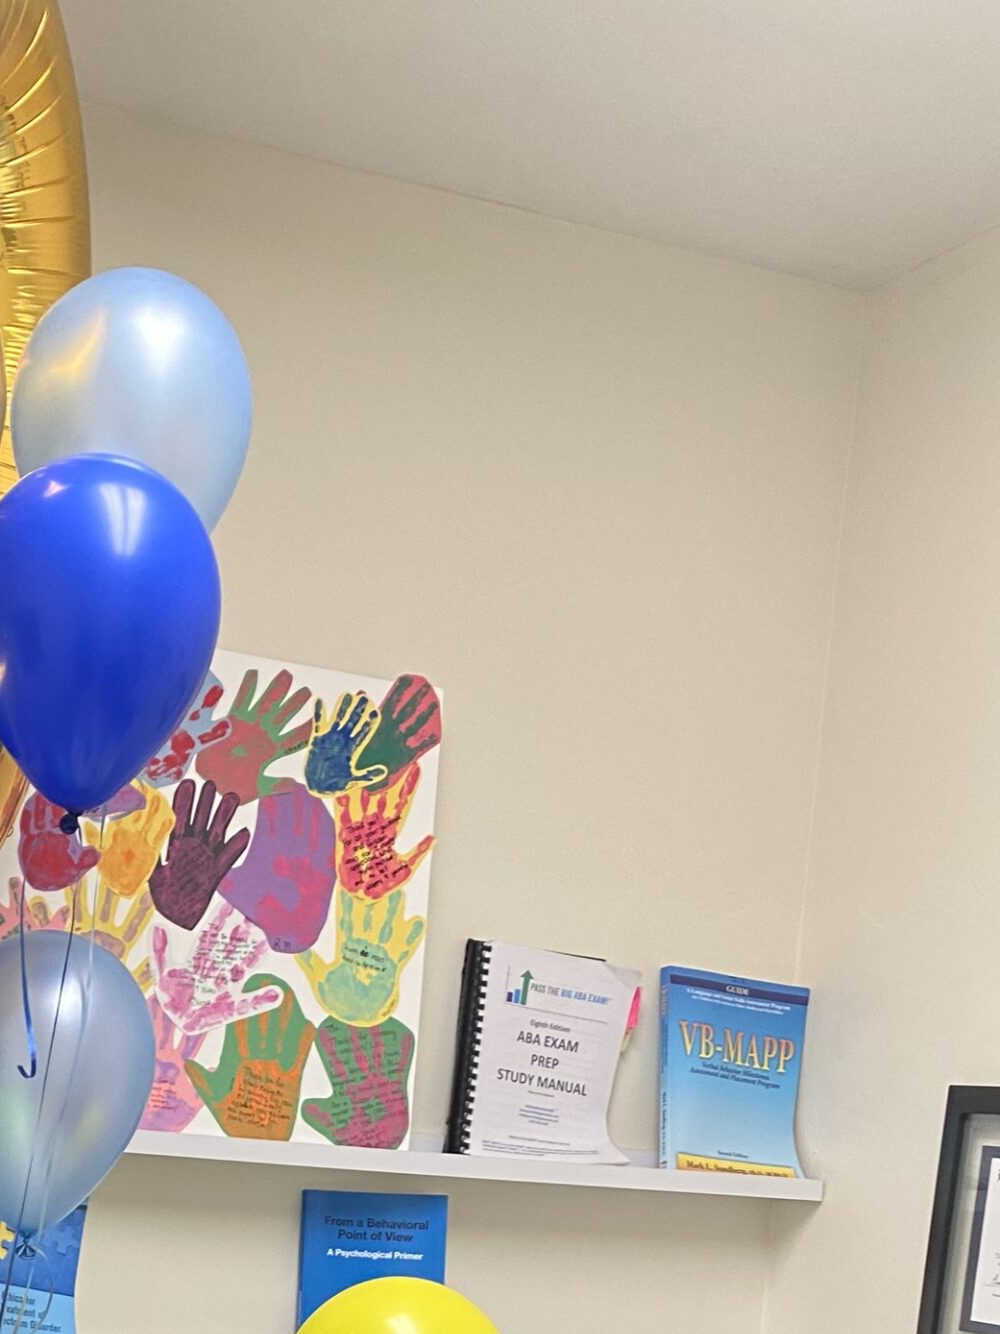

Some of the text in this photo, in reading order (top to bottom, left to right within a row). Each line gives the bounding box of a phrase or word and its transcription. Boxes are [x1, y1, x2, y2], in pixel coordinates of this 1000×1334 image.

[530, 982, 547, 994] PASS
[547, 986, 561, 997] THE
[561, 988, 573, 999] BIG
[573, 991, 587, 1001] ABA
[725, 985, 750, 996] GUIDE
[529, 1019, 571, 1033] Eighth Edition
[516, 1030, 580, 1053] ABA EXAM
[679, 1020, 796, 1074] VB-MAPP
[530, 1053, 560, 1069] PREP
[496, 1067, 587, 1096] STUDY MANUAL
[324, 1215, 430, 1231] From a Behavioral
[338, 1229, 415, 1243] Point of View
[326, 1248, 424, 1261] A Psychological Primer
